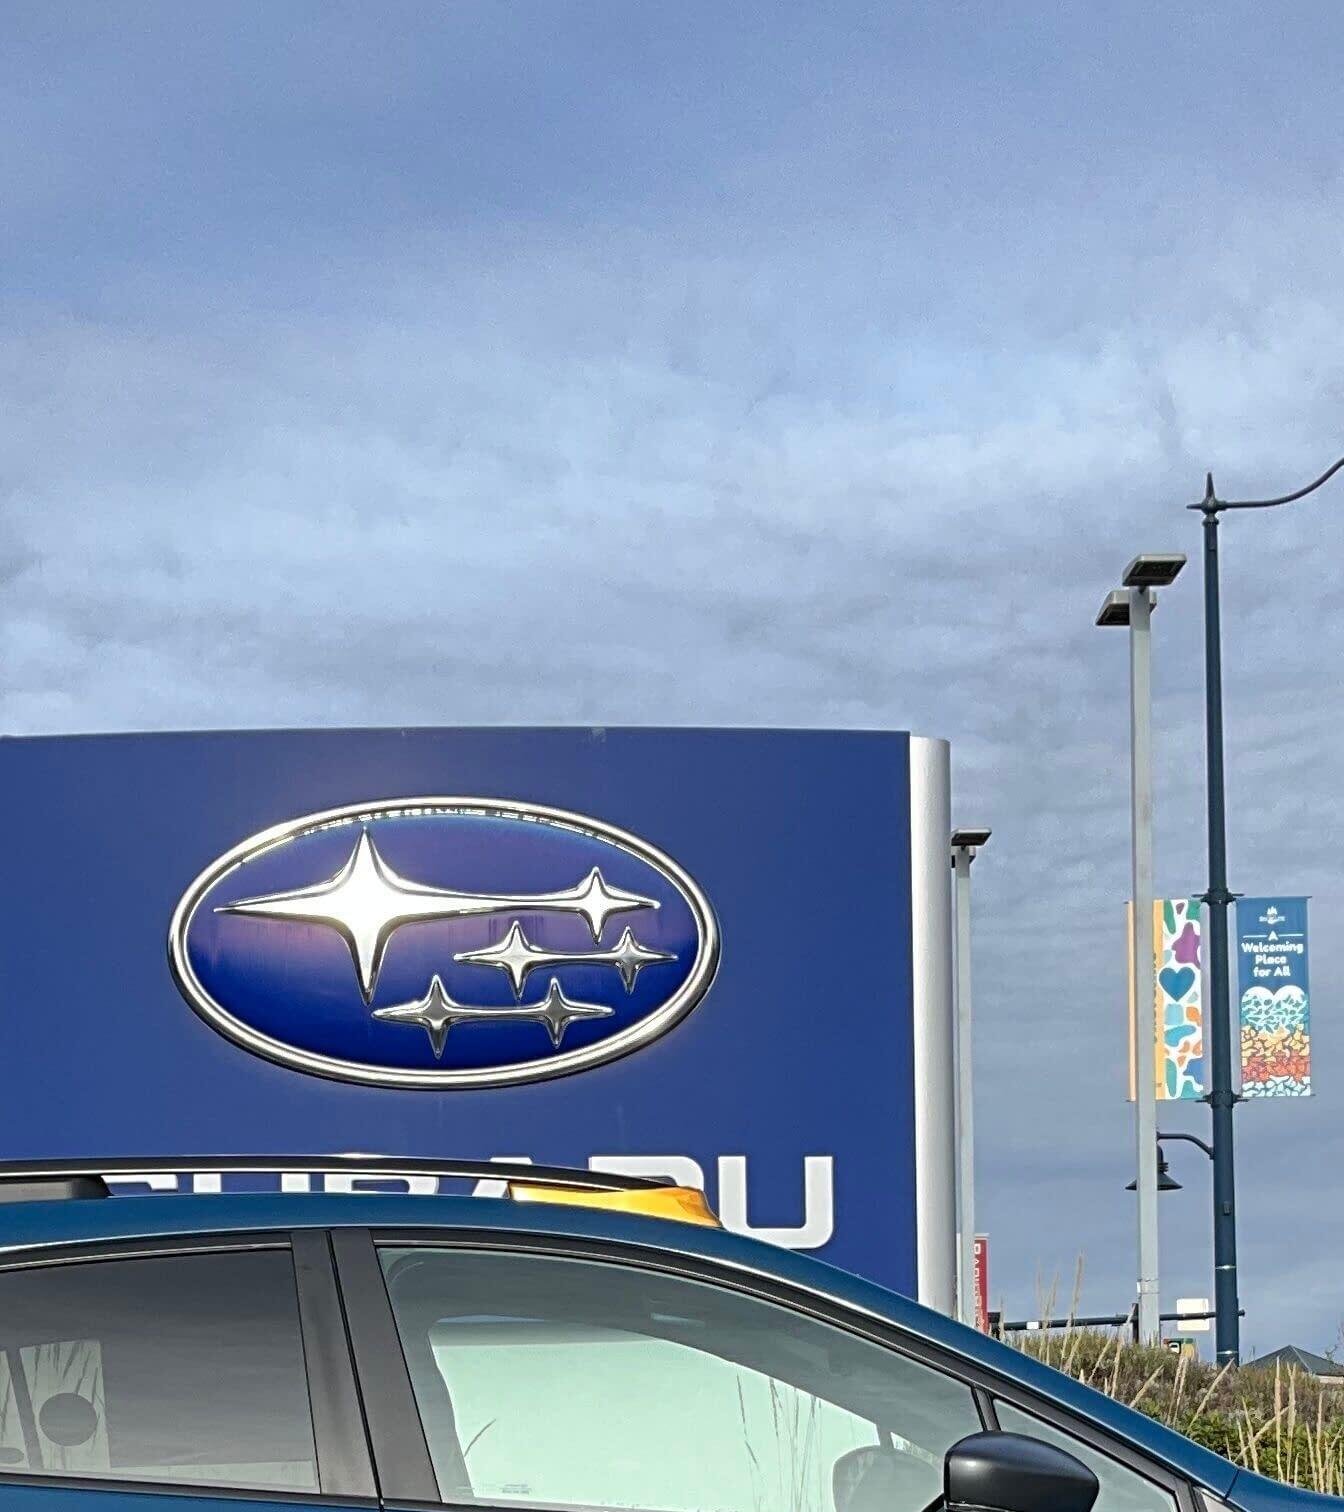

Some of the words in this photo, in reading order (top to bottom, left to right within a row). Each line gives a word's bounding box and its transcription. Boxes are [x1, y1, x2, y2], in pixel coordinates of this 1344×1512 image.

[1268, 930, 1279, 941] A
[1241, 941, 1304, 954] Welcoming
[1255, 954, 1287, 965] Place
[1253, 966, 1272, 977] for
[1273, 965, 1291, 977] All
